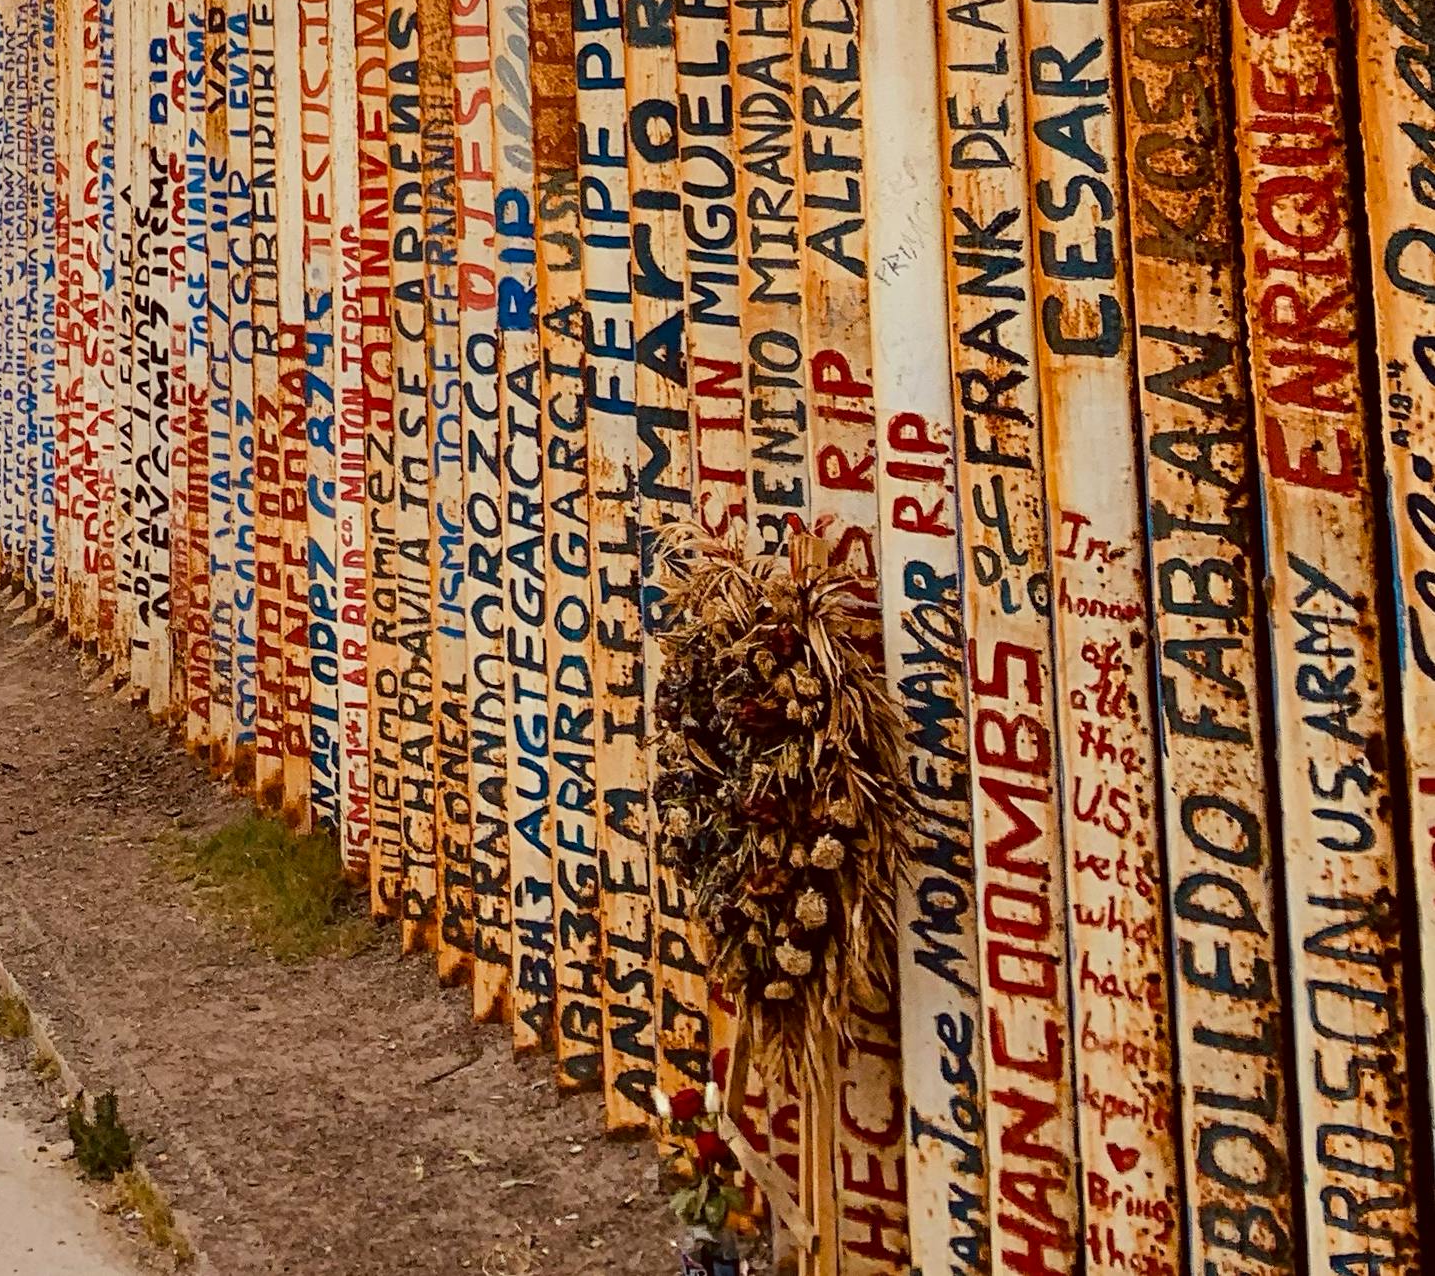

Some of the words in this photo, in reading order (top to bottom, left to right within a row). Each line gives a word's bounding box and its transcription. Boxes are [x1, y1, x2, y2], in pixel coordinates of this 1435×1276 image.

[574, 118, 639, 417] FELIPE
[674, 36, 742, 328] MIGUEL
[734, 52, 805, 298] MIRANDA
[1029, 36, 1127, 360] CESAR
[1248, 60, 1367, 498] ENRIQUE
[952, 206, 1033, 470] FRANK
[1140, 322, 1256, 753] FABIAN
[1286, 548, 1369, 746] ARMY
[1169, 792, 1294, 1276] BOLLEDO
